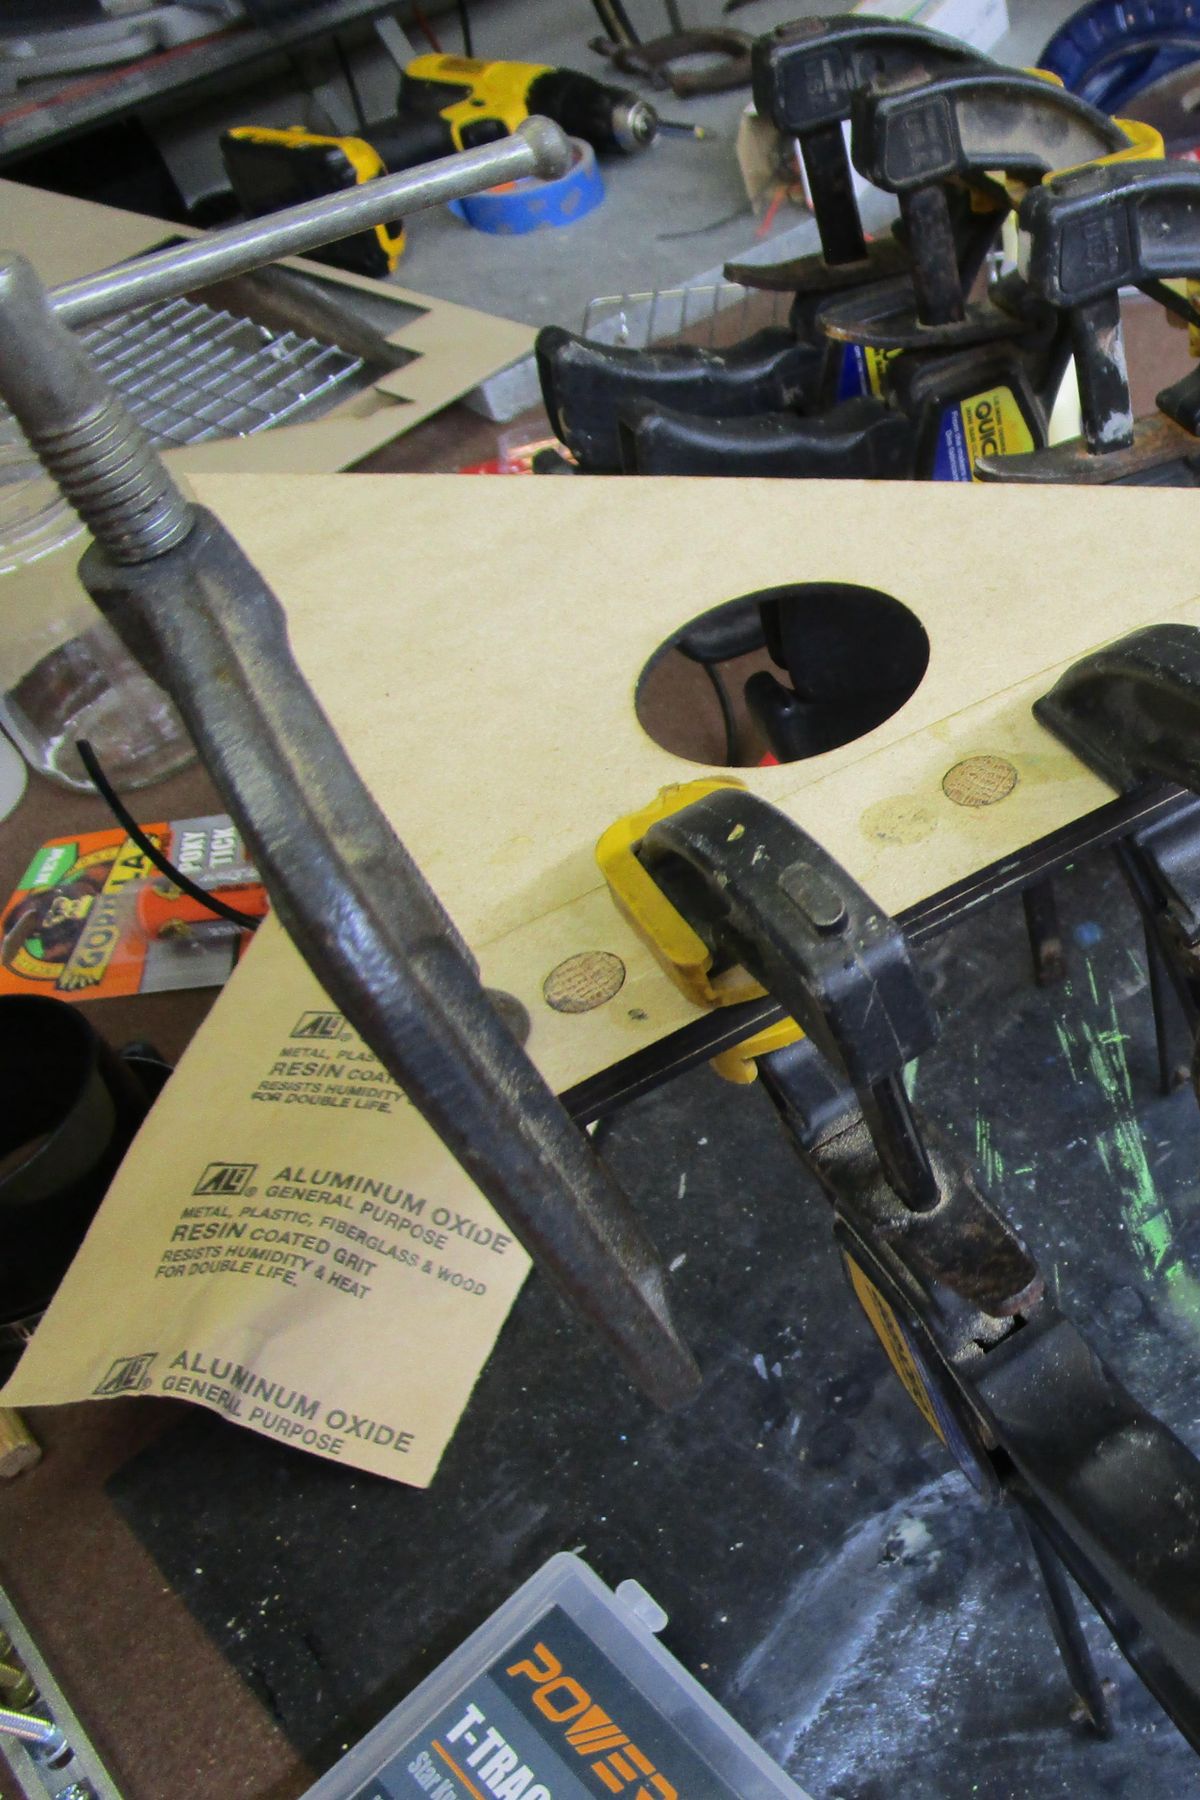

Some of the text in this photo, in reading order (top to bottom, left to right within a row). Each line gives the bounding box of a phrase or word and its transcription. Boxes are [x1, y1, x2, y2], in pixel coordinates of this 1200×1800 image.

[975, 401, 998, 456] QUIC
[178, 831, 207, 873] POXY
[209, 825, 239, 868] TICK
[258, 1080, 405, 1102] RESISTS HUMIDITY
[269, 1062, 345, 1078] RESIN
[252, 1091, 393, 1113] FOR DOUBLE LIFE.
[265, 1185, 449, 1250] GENERAL PURPOSE
[274, 1166, 512, 1255] ALUMINUM OXIDE
[155, 1260, 297, 1286] FOR DOUBLE LIFE.
[161, 1245, 372, 1299] RESISTS HUMIDITY & HEAT
[171, 1222, 377, 1277] RESIN COATED GRIT
[239, 1206, 313, 1227] PLASTIC,
[318, 1216, 420, 1267] FIBERGLASS
[421, 1260, 434, 1275] &
[437, 1265, 488, 1296] WOOD
[169, 1350, 415, 1453] ALUMINUM OXIDE
[248, 1408, 345, 1455] PURPOSE
[408, 1751, 442, 1791] Star
